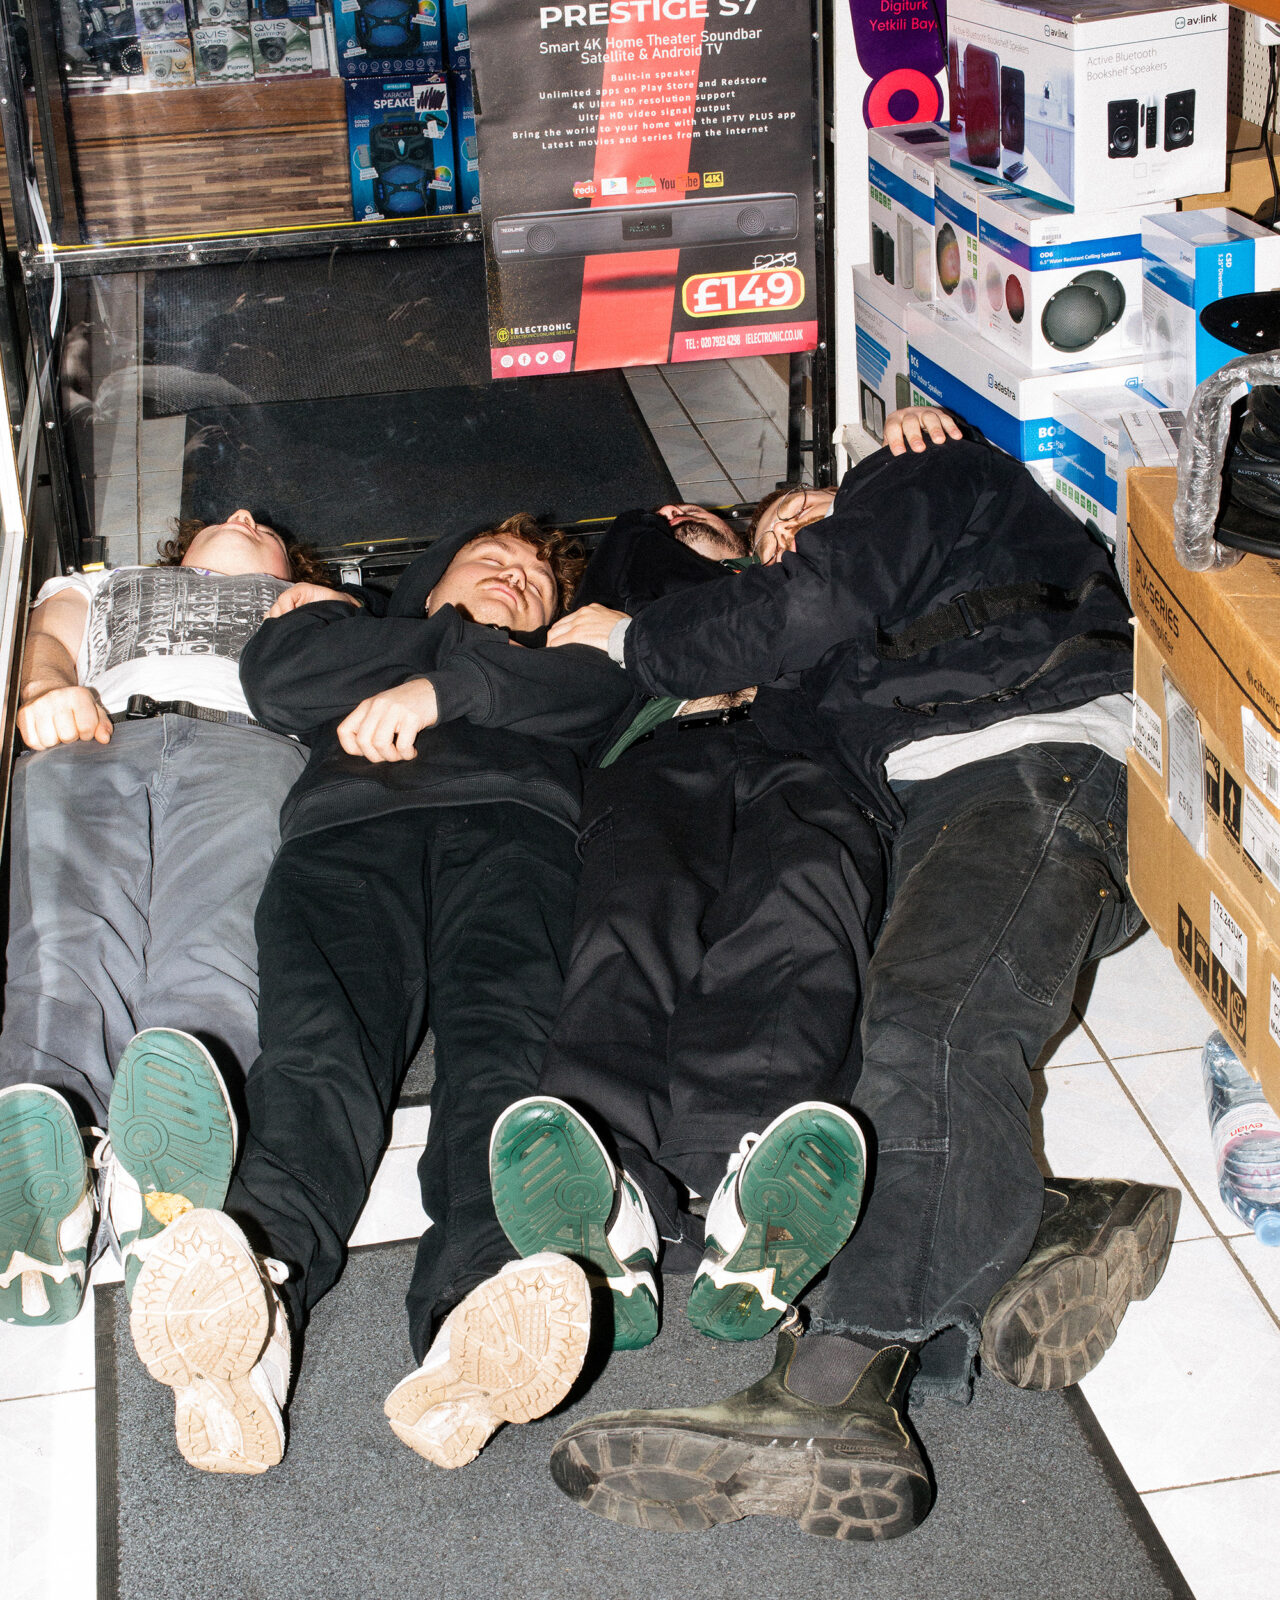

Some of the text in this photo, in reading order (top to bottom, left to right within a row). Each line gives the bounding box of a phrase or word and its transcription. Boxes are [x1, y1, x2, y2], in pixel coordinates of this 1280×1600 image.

[540, 0, 758, 29] PRESTIGE S7
[880, 0, 928, 15] Digiturk
[254, 22, 286, 31] QVIS
[869, 18, 907, 32] Yetkili
[1187, 13, 1218, 26] av:link
[195, 30, 227, 39] QVIS
[539, 27, 763, 54] Smart 4K Home Theater Soundbar
[581, 42, 723, 64] Satellite & Android TV
[1087, 48, 1158, 66] Active Bluetooth
[611, 69, 696, 82] Built-in speaker
[1086, 61, 1168, 81] Bookshelf Speakers
[383, 90, 412, 98] KARAOKE
[539, 88, 591, 100] Unlimited
[596, 88, 620, 97] apps
[641, 84, 662, 93] Play
[667, 82, 694, 91] Store
[698, 79, 717, 88] and
[721, 76, 767, 87] Redstore
[373, 97, 416, 110] SPEAKE
[572, 90, 736, 110] 4K Ultra HD resolution support
[578, 103, 731, 121] Ultra HD video signal output
[512, 111, 796, 140] Bring the world to your home with the IPTV PLUS app
[542, 125, 769, 149] Latest movies and series from the internet
[659, 177, 698, 190] Yoube
[704, 174, 722, 183] 4K
[752, 251, 797, 272] £239
[1101, 251, 1122, 259] Speakers
[1225, 252, 1233, 268] CSD
[693, 272, 794, 313] £149
[510, 322, 572, 335] IELECTRONIC
[700, 337, 712, 348] 020
[712, 336, 727, 347] 7923
[726, 334, 741, 346] 4298
[745, 329, 804, 345] IELECTRONIC.CO.UK
[927, 380, 943, 399] Speakers
[994, 380, 1016, 401] adastra
[1230, 1122, 1263, 1137] evian
